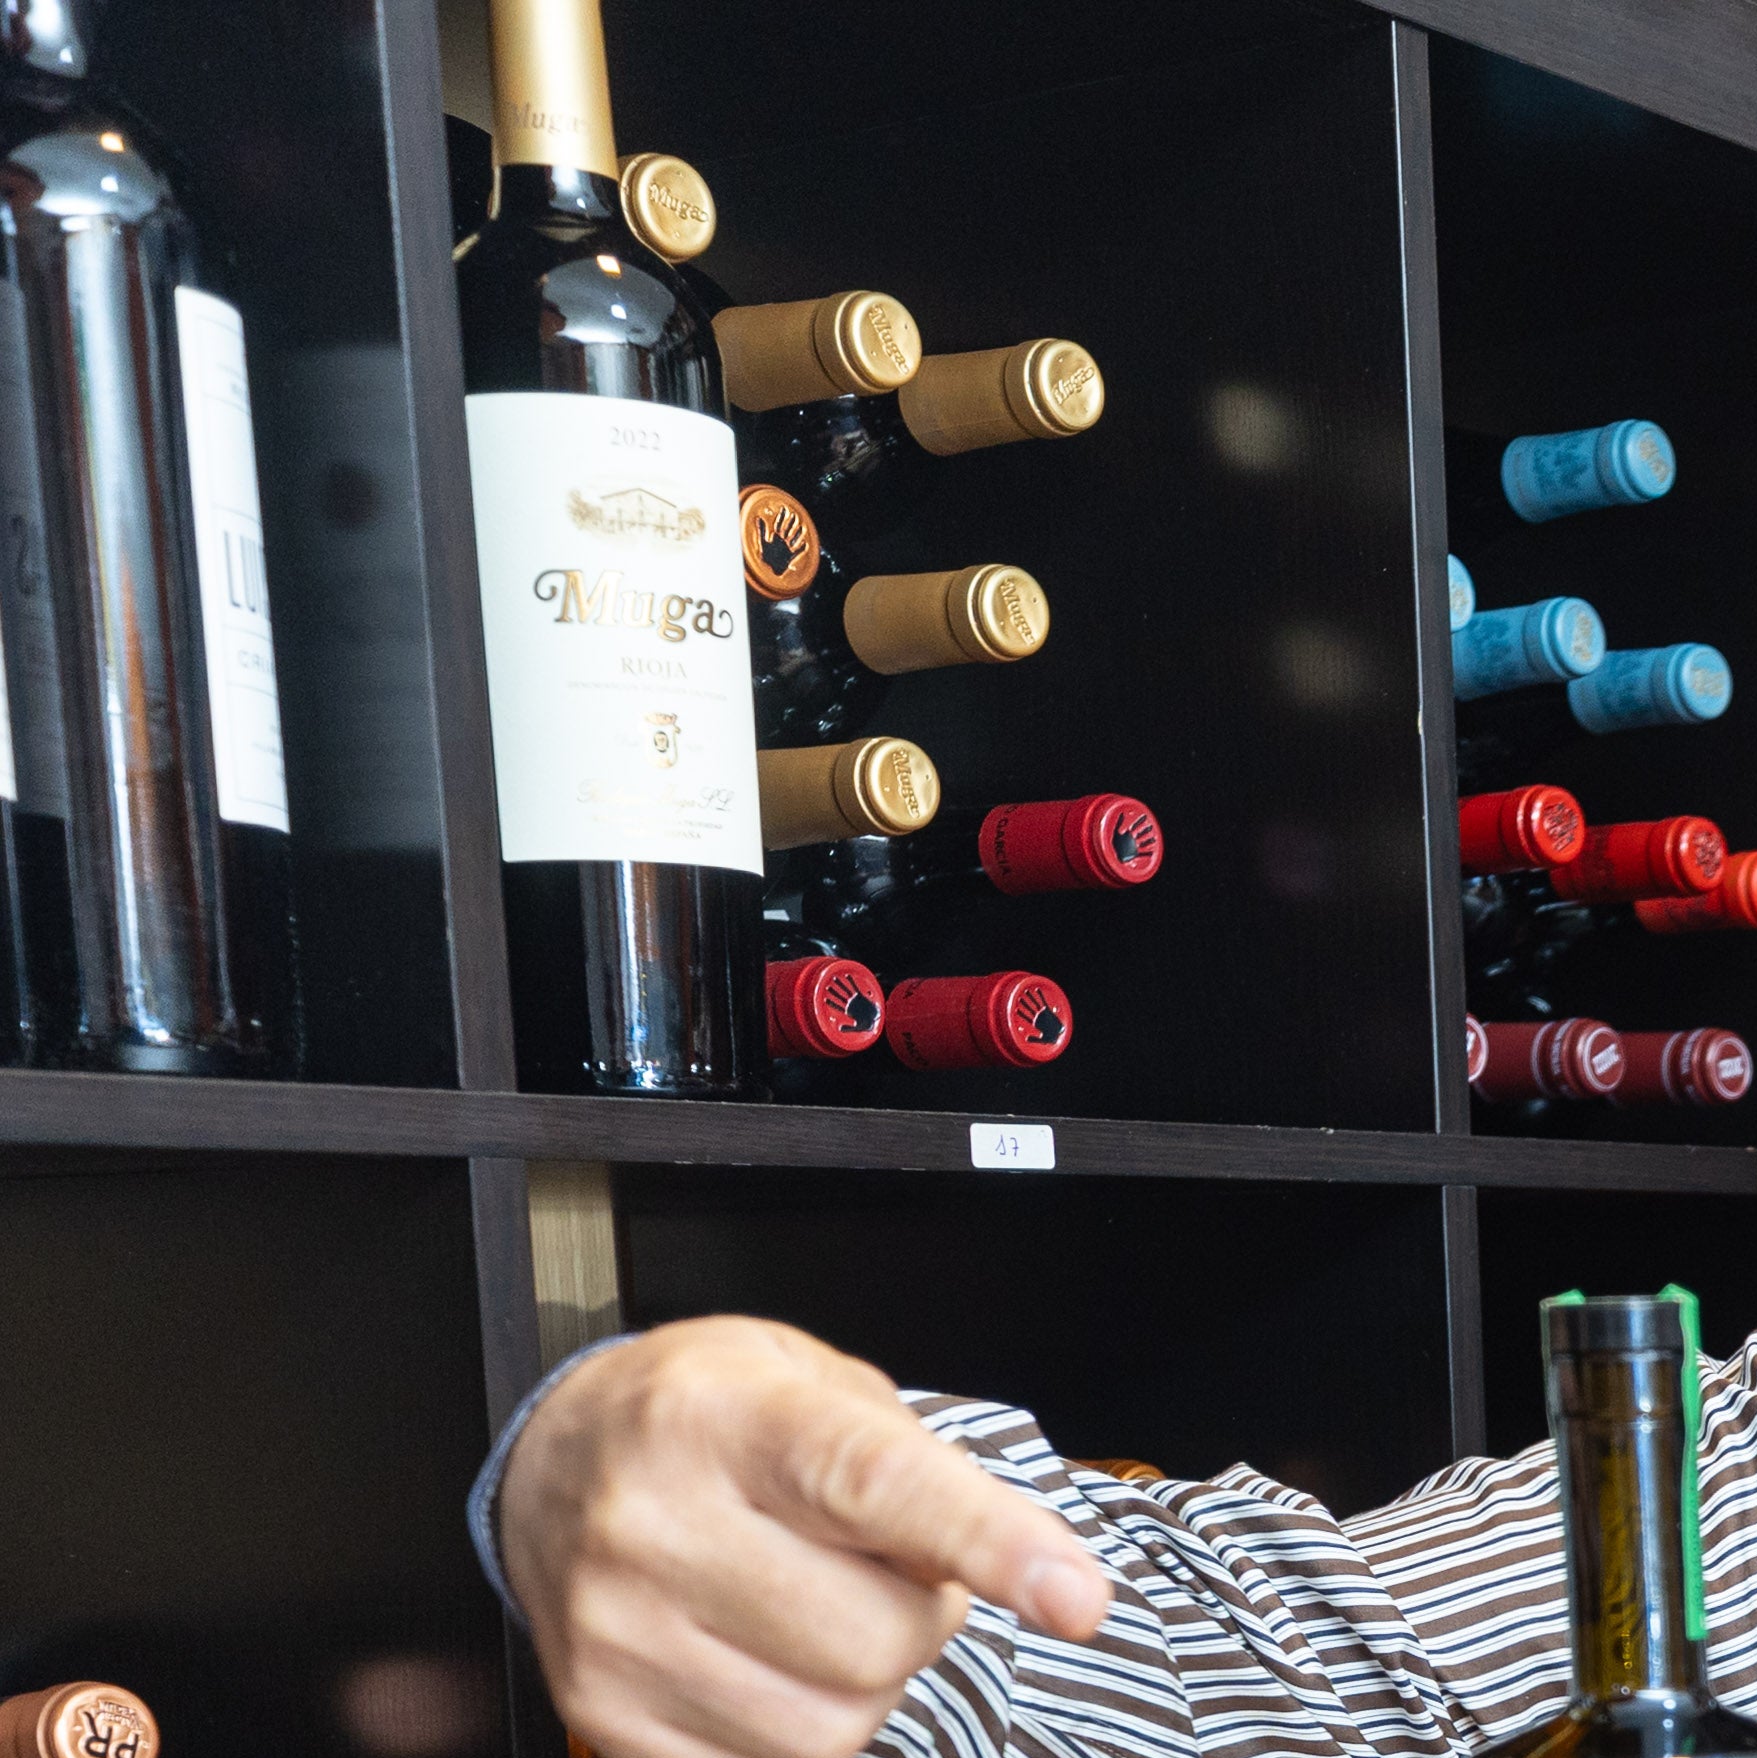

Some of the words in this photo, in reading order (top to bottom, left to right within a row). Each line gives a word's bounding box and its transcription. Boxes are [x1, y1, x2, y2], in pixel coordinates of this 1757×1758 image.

[609, 425, 662, 452] 2022
[533, 567, 734, 643] Muga
[619, 655, 688, 679] RIOJA
